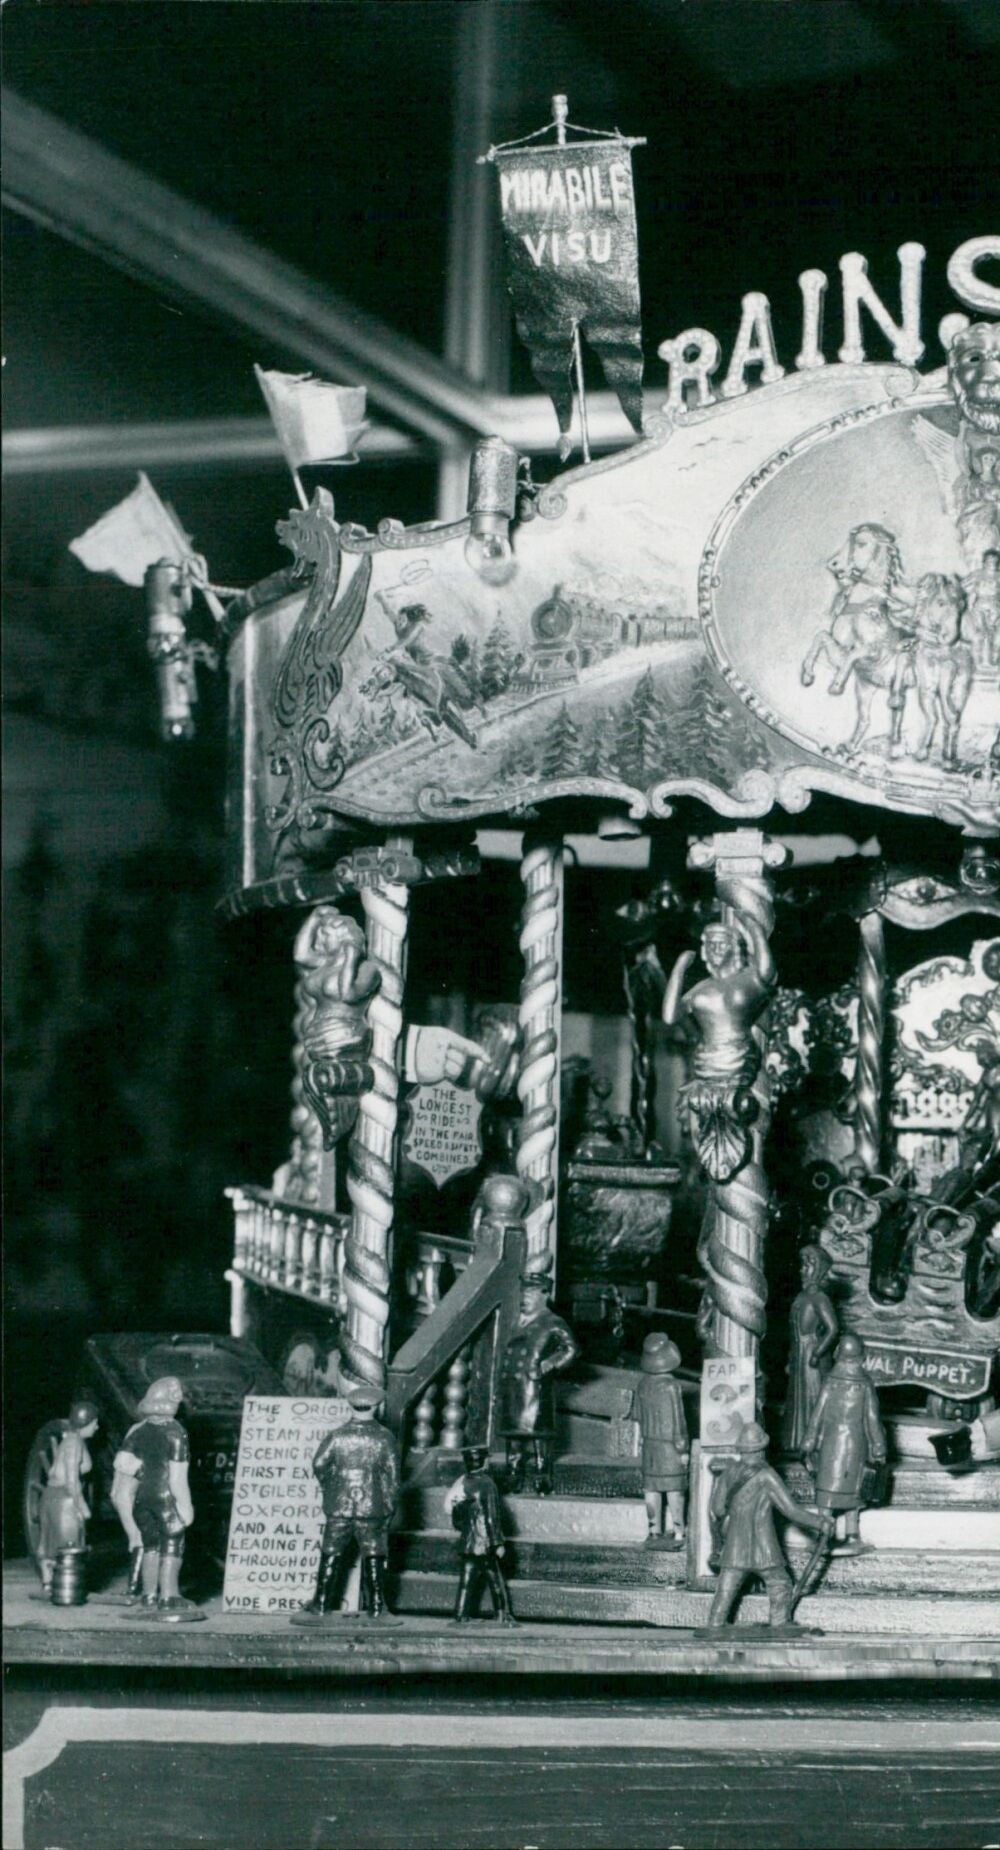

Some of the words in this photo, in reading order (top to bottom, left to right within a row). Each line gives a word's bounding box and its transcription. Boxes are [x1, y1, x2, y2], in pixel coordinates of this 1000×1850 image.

[500, 162, 632, 214] MIRABILE
[522, 228, 612, 267] VISU
[432, 1088, 456, 1101] THE
[419, 1098, 472, 1116] LONGEST
[430, 1114, 455, 1128] RIDE
[415, 1126, 426, 1137] IN
[430, 1127, 449, 1140] THE
[453, 1131, 474, 1140] FAIR
[413, 1138, 442, 1150] SPEED
[416, 1150, 469, 1164] COMBINED
[708, 1363, 738, 1379] FAR
[247, 1400, 281, 1415] THE
[245, 1427, 300, 1441] STEAM
[242, 1446, 300, 1460] SCENIC
[241, 1466, 286, 1479] FIRST
[259, 1483, 307, 1499] GILES
[236, 1504, 322, 1518] OXFORD
[233, 1522, 266, 1535] AND
[273, 1522, 304, 1535] ALL
[230, 1538, 297, 1551] LEADING
[229, 1553, 319, 1568] THROUGHOU
[225, 1595, 260, 1610] VIDE
